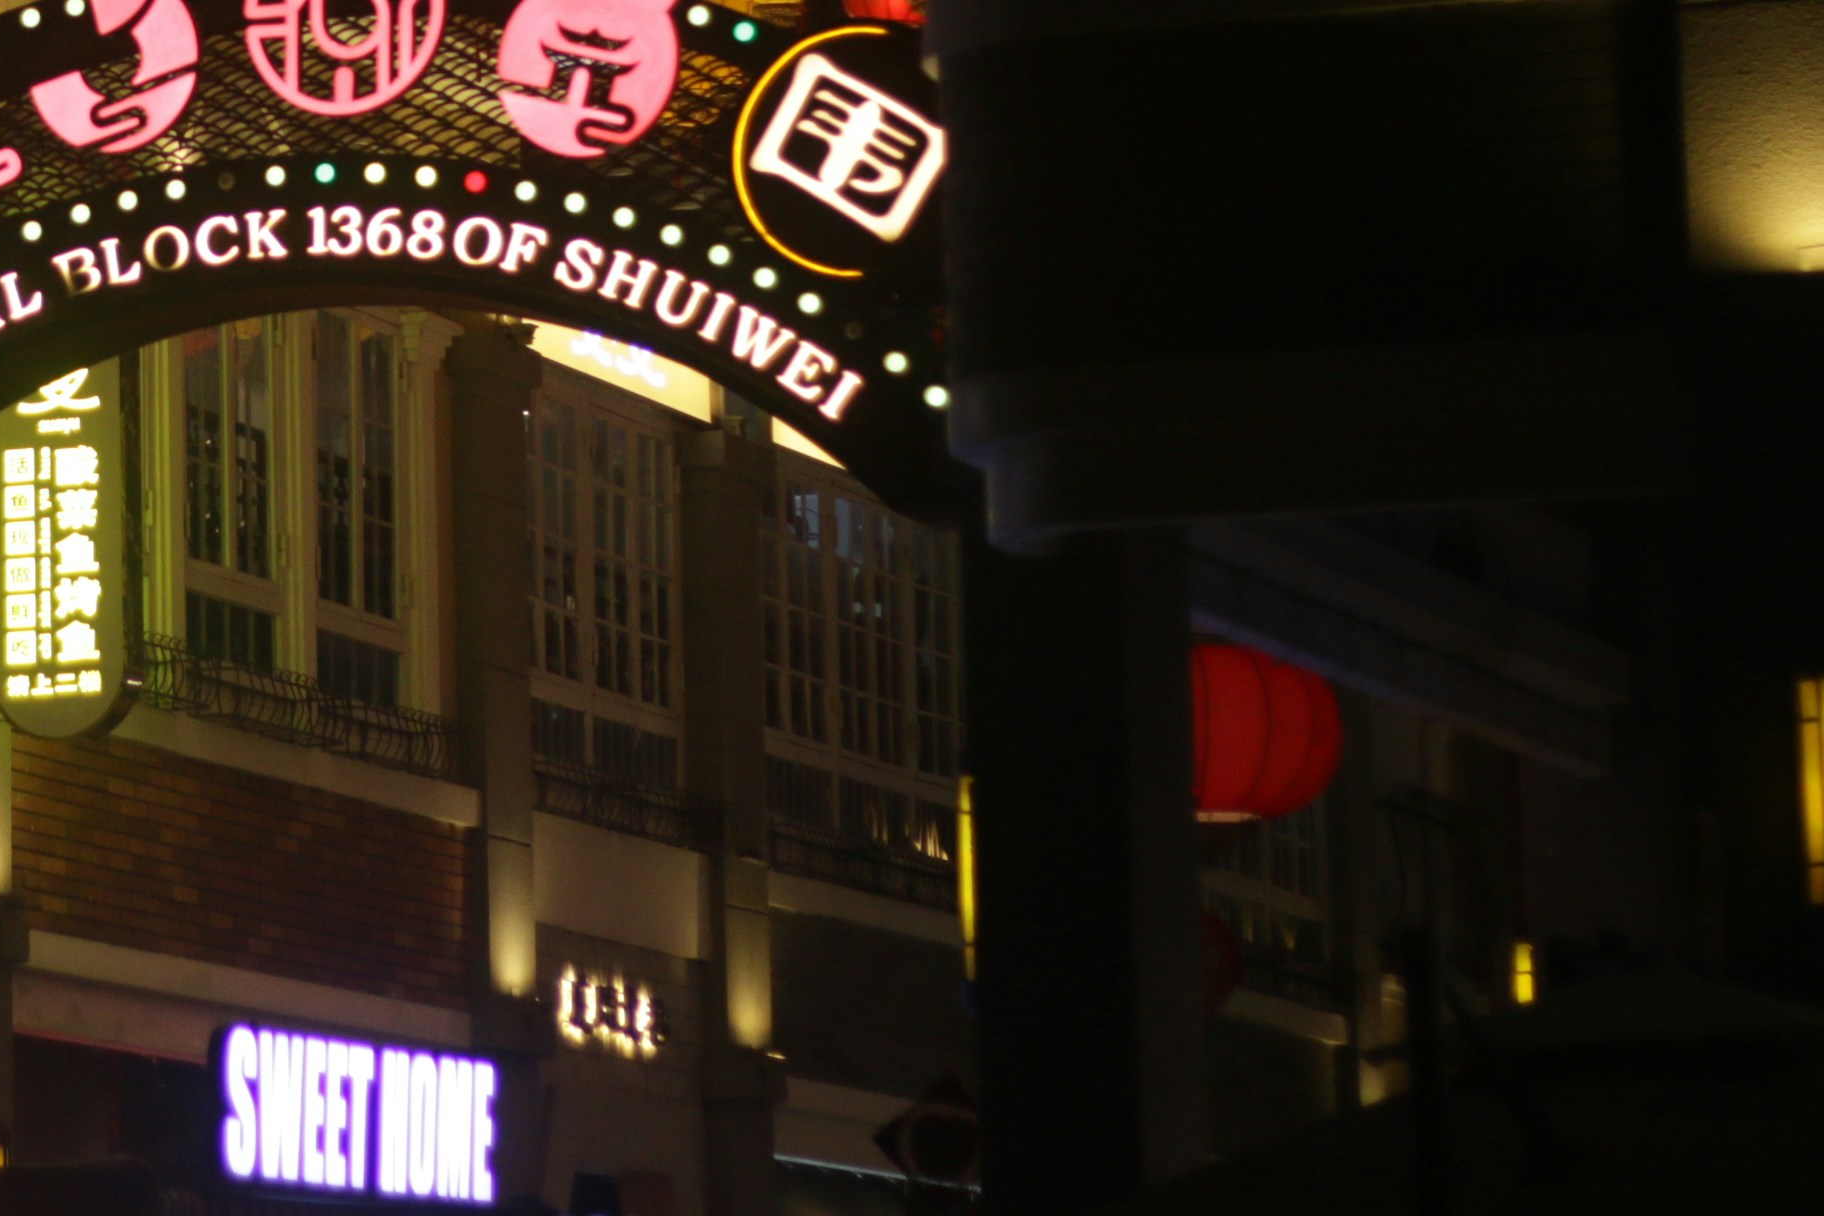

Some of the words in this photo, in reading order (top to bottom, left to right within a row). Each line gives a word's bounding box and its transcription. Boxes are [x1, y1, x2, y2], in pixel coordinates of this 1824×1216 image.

[750, 52, 948, 243] 围
[51, 208, 289, 297] BLOCK
[306, 205, 446, 261] 1368
[452, 215, 550, 273] OF
[552, 237, 865, 422] SHUIWEI
[223, 1025, 376, 1189] SWEET
[380, 1046, 495, 1203] HOME
